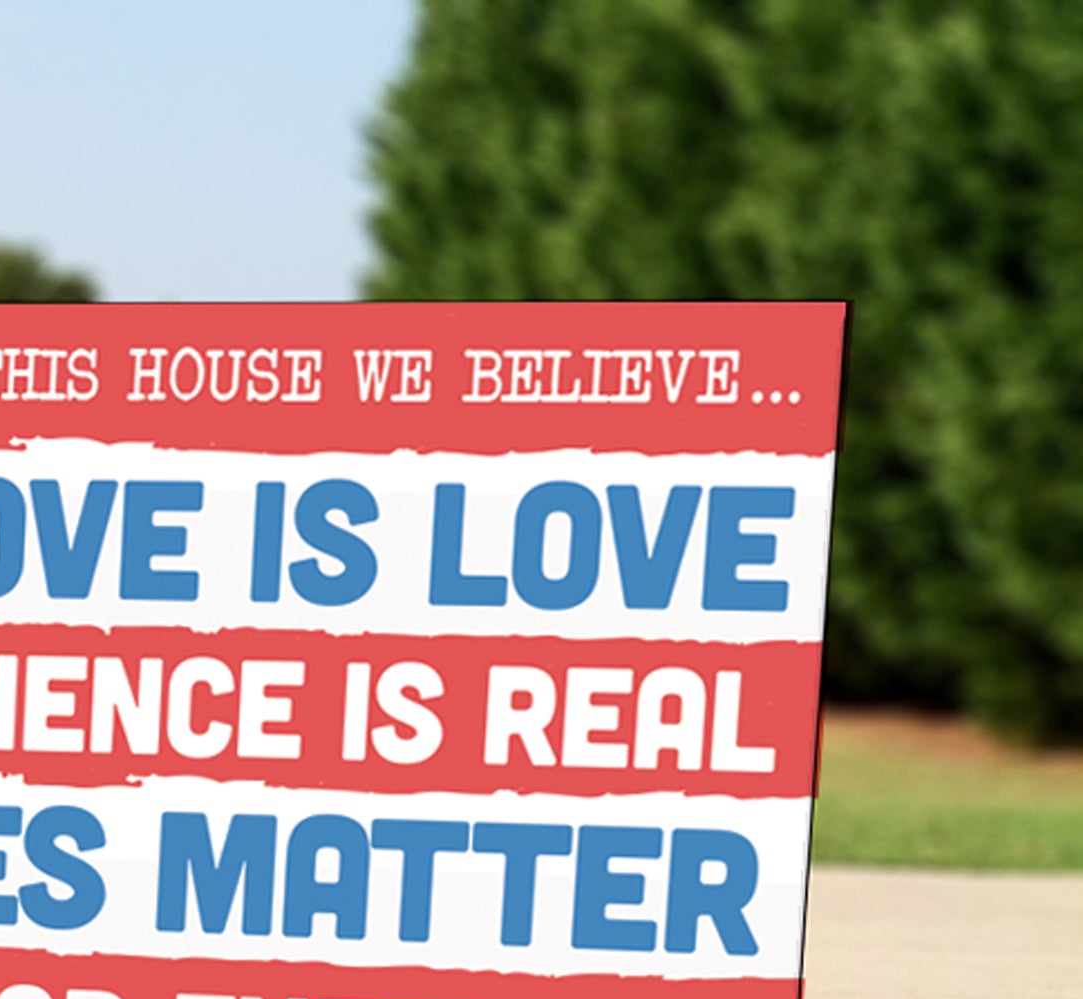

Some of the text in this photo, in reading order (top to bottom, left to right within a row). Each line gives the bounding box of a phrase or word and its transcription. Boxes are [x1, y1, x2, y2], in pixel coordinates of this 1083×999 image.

[127, 346, 322, 402] HOUSE
[353, 349, 433, 403] WE
[461, 349, 801, 404] BELIEVE...
[250, 478, 380, 607] IS
[428, 480, 796, 613] LOVE
[342, 661, 444, 764] IS
[483, 665, 776, 773] REAL
[155, 811, 759, 957] MATTER
